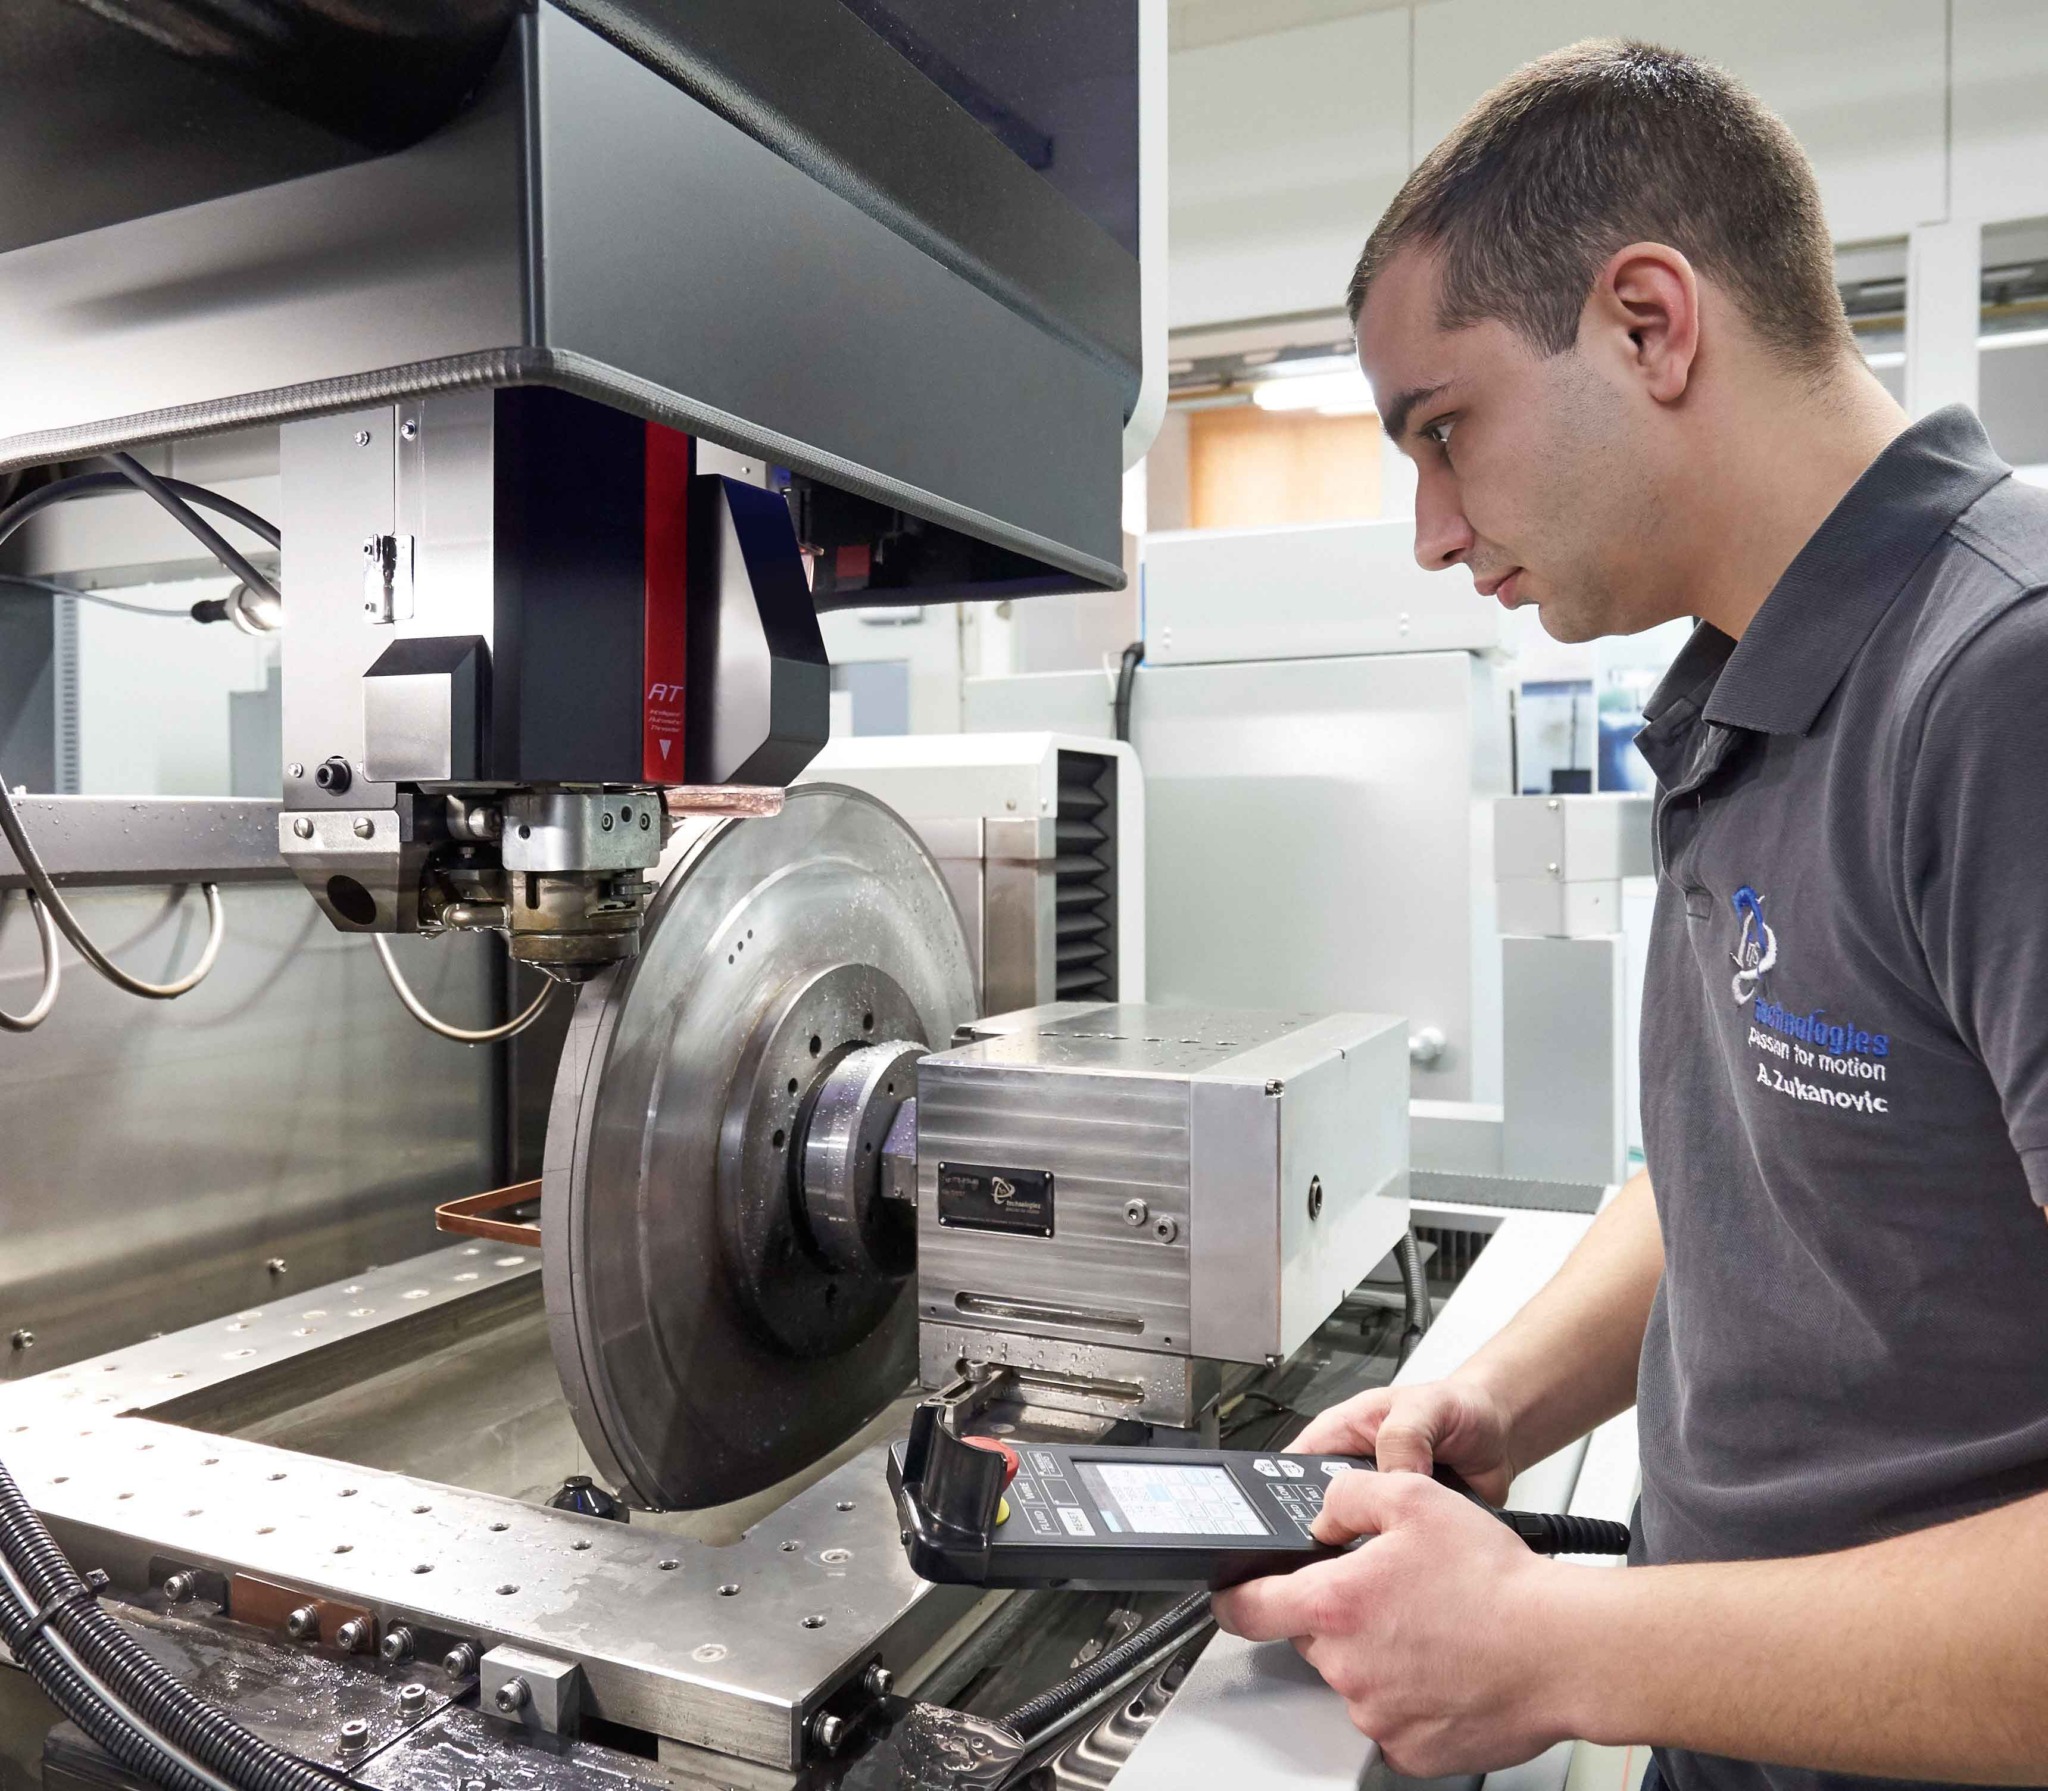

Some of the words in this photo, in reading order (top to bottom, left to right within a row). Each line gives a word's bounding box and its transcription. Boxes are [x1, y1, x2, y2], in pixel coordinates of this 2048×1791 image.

[648, 683, 684, 702] AT
[1818, 1054, 1886, 1081] motion
[1034, 1510, 1052, 1531] FLUID
[1067, 1511, 1085, 1531] RESET
